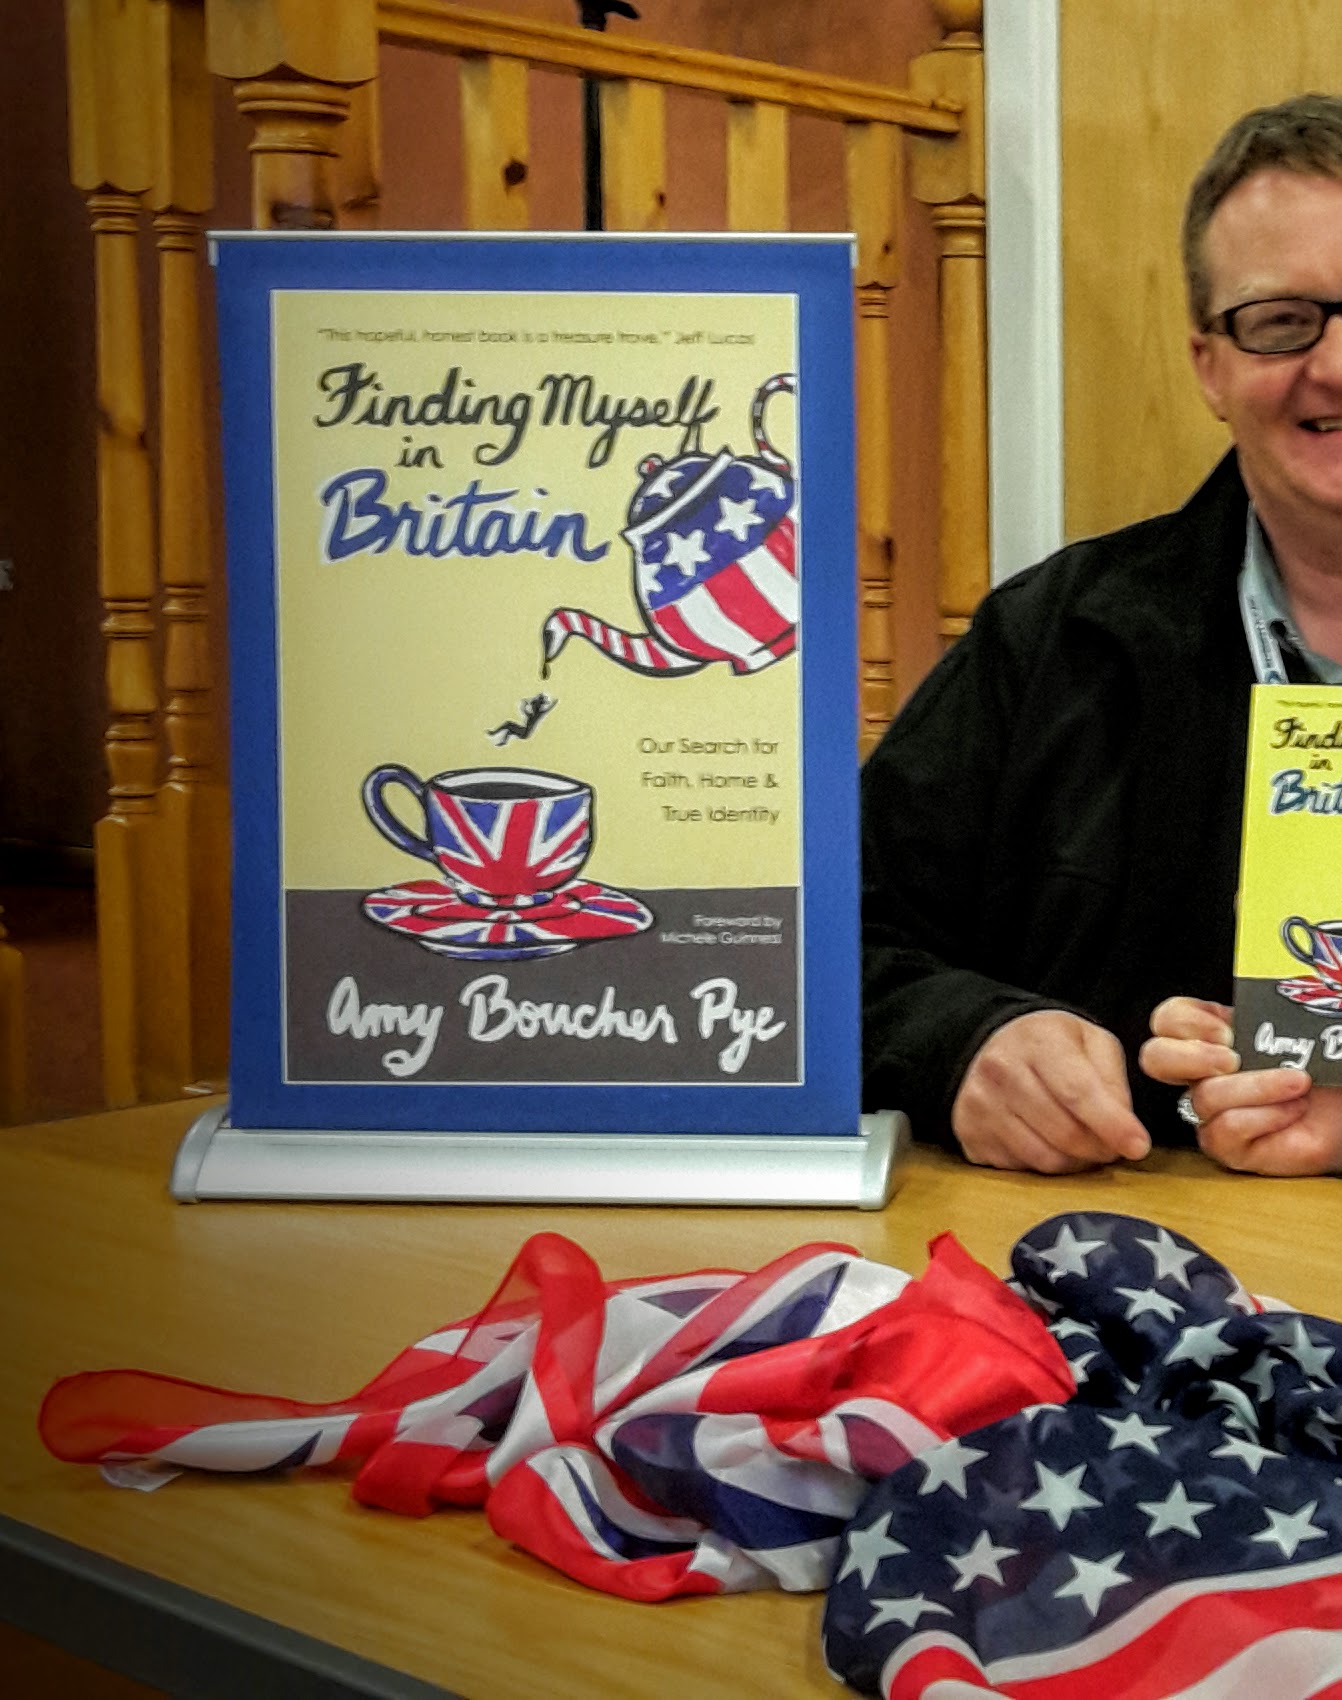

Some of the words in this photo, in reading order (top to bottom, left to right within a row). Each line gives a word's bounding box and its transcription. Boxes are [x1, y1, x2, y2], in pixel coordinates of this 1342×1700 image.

[315, 362, 532, 468] Finding
[539, 374, 720, 469] Myself
[396, 436, 444, 469] in
[321, 467, 610, 563] Britain
[640, 737, 676, 754] Our
[678, 737, 749, 754] Search
[752, 737, 780, 754] for
[1308, 754, 1332, 771] in
[700, 771, 759, 789] Home
[763, 772, 779, 789] &
[661, 805, 702, 822] True
[705, 805, 780, 826] Identity
[328, 976, 444, 1076] Amy
[459, 974, 679, 1044] Boucher
[690, 977, 787, 1075] Pye
[1254, 1021, 1315, 1070] Amy
